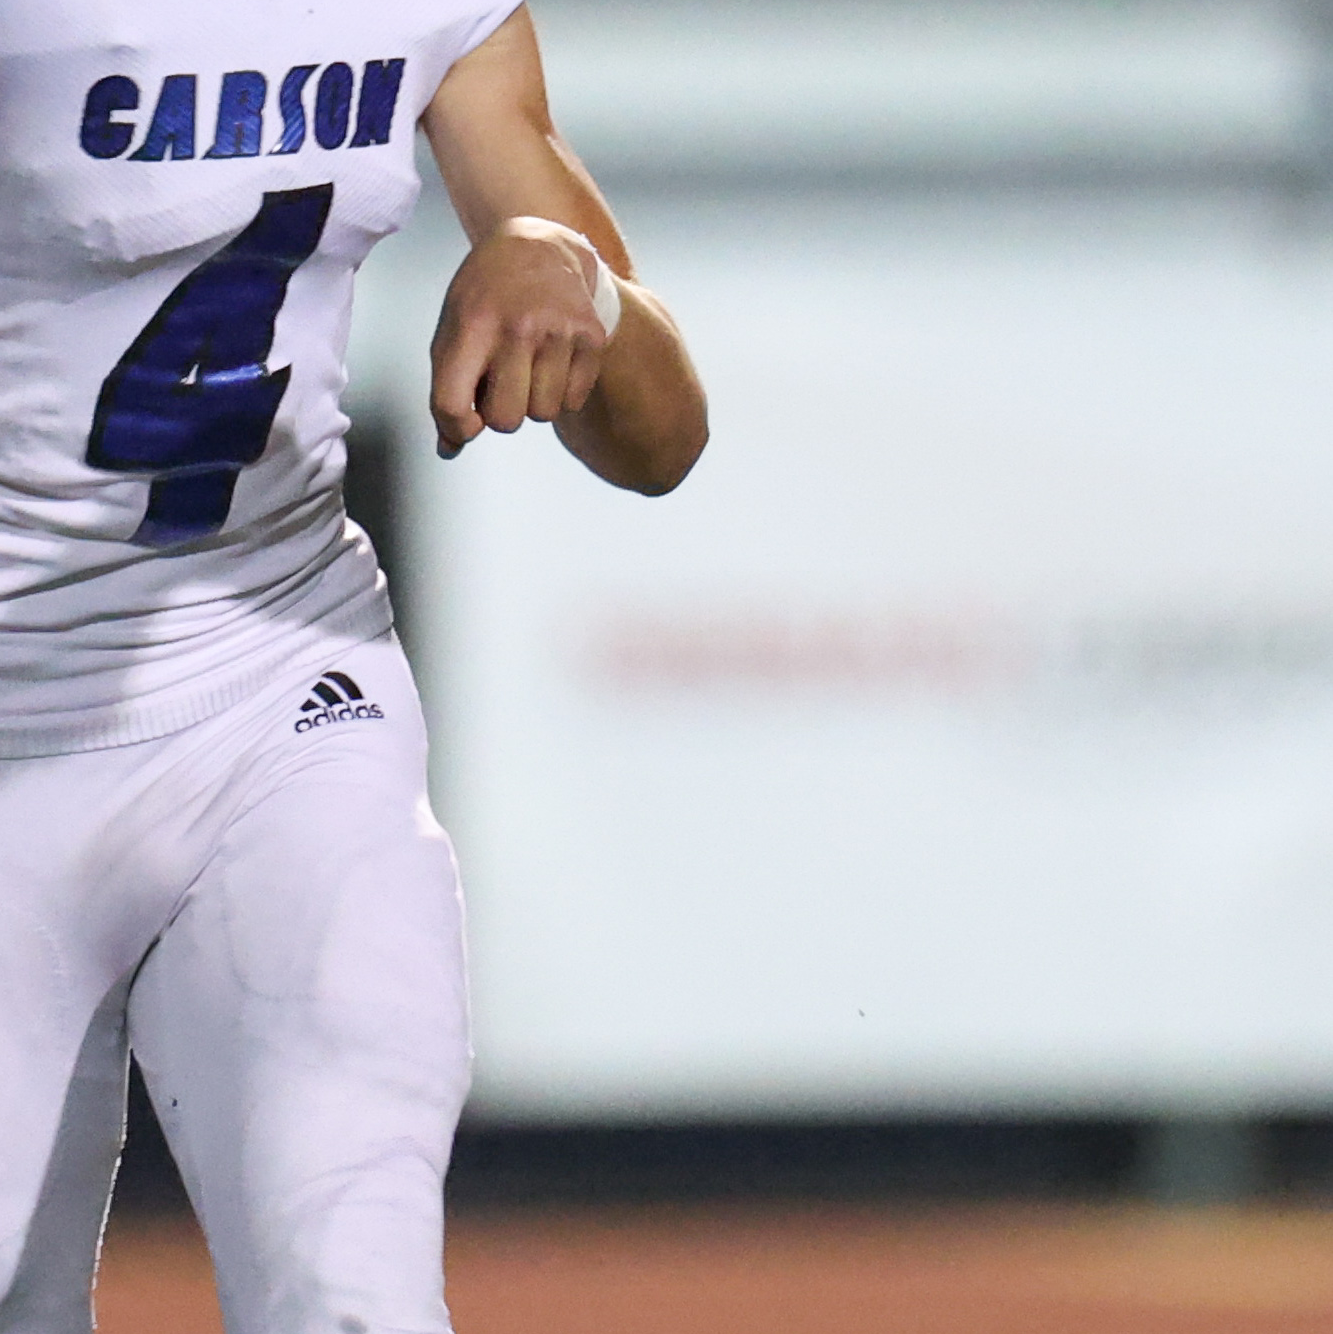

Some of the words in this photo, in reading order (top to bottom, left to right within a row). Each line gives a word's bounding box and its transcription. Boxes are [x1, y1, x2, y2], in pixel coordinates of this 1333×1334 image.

[79, 57, 407, 162] CARSON
[85, 181, 334, 549] 4
[294, 701, 385, 734] adidas
